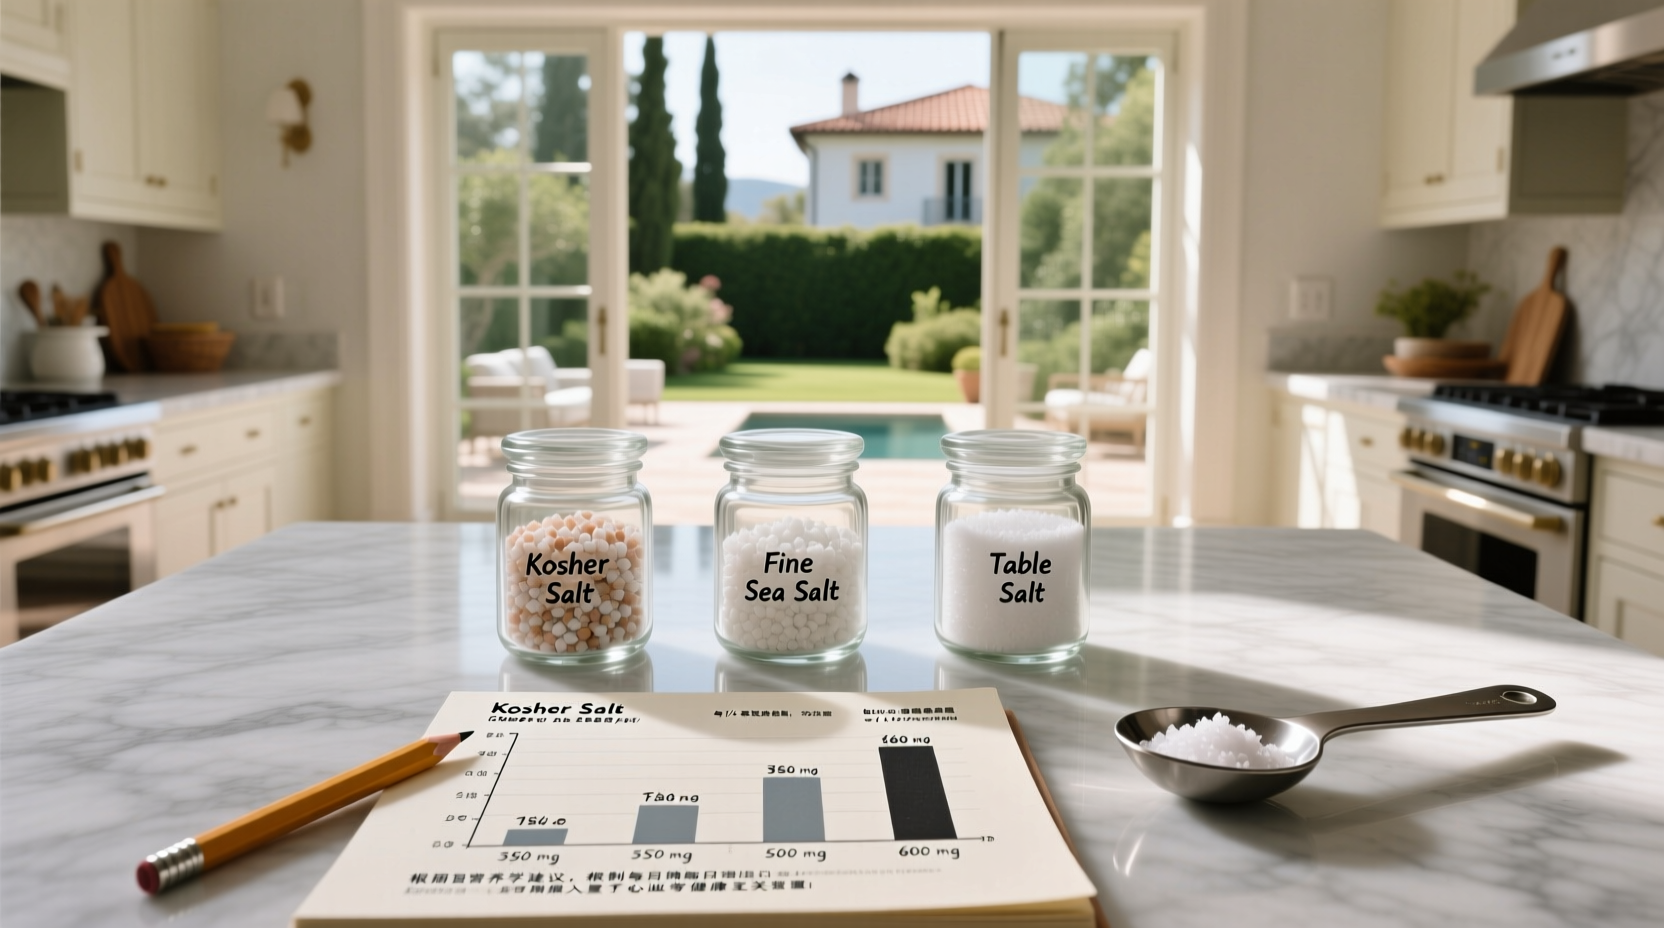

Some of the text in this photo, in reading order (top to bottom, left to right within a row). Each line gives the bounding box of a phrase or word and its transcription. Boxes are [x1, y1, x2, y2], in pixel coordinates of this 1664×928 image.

[525, 551, 610, 577] Kosher
[764, 551, 814, 574] Fine
[989, 550, 1052, 575] Table
[545, 580, 595, 605] Salt
[744, 579, 840, 602] Sea Salt
[998, 580, 1046, 604] Salt
[578, 702, 625, 715] Salt
[536, 853, 561, 866] mg
[669, 852, 694, 865] mg
[765, 848, 828, 863] 500 mg
[898, 846, 961, 861] 600 mg
